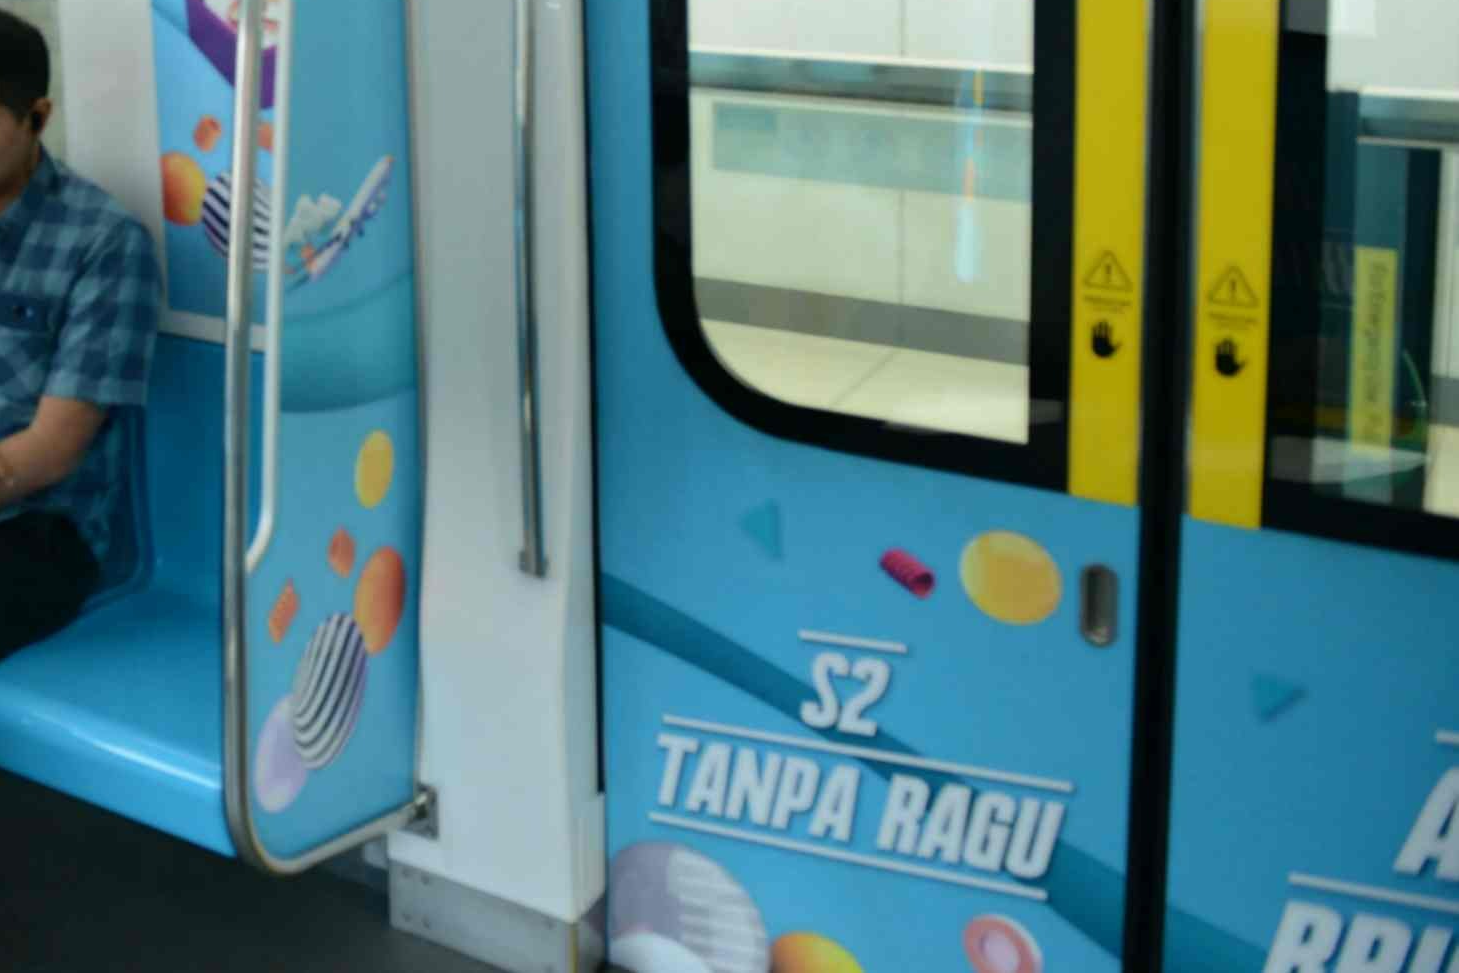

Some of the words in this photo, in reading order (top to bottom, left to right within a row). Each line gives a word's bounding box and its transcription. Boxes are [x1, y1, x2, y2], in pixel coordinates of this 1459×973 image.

[799, 652, 891, 737] S2
[656, 733, 861, 842] TANPA
[876, 773, 1065, 880] RAGU
